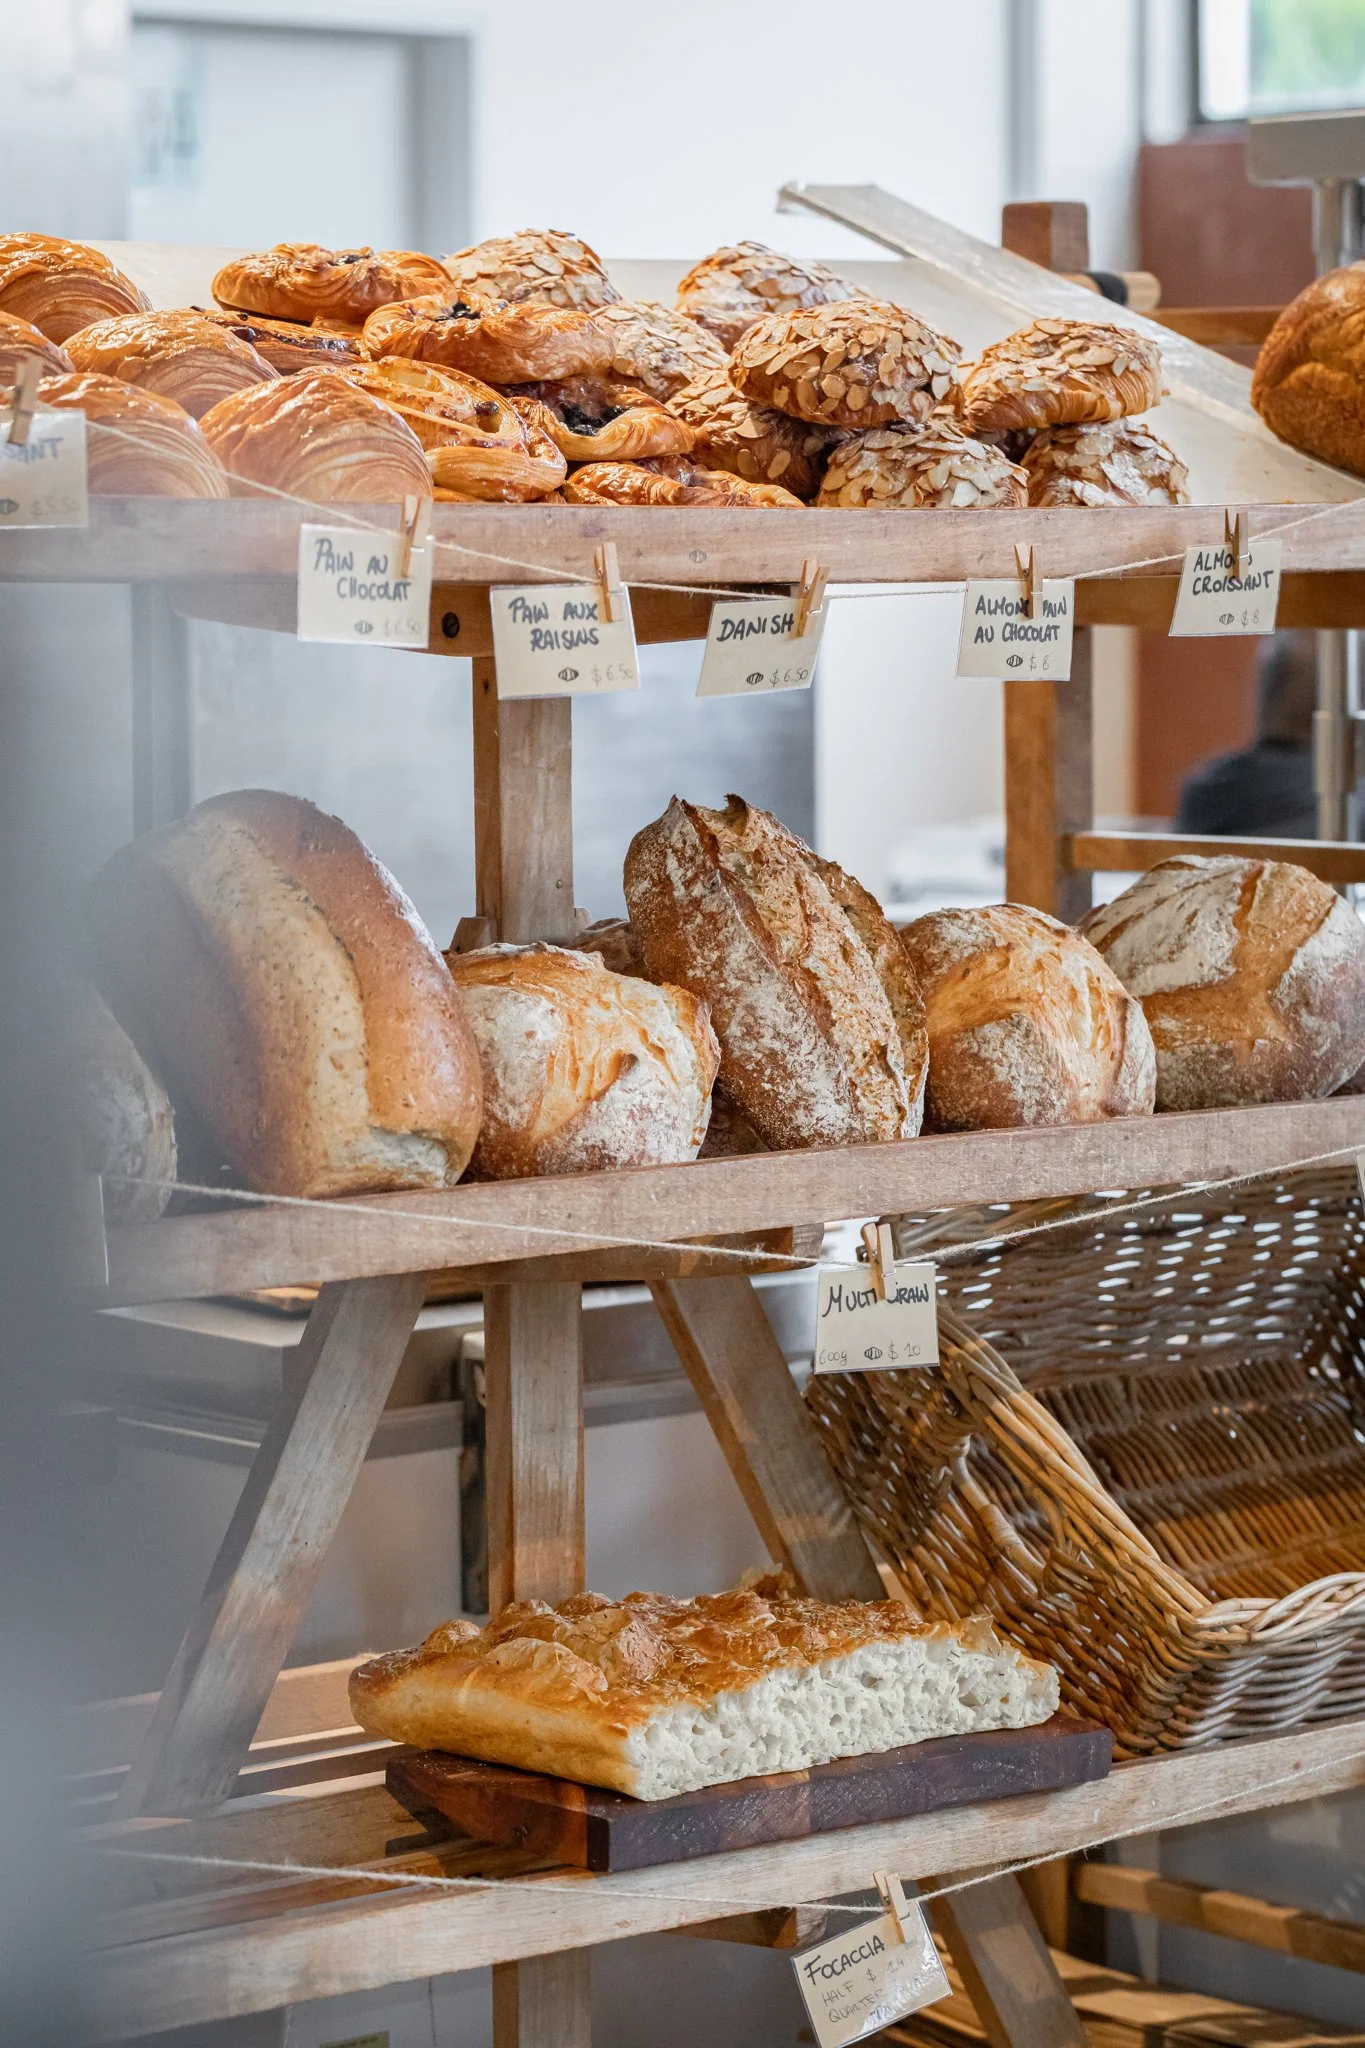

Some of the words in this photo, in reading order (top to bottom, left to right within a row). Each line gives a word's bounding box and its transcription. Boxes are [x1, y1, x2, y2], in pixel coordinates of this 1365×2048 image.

[313, 537, 354, 574] PAIN
[366, 554, 389, 575] AU
[1193, 549, 1253, 572] ALMO
[336, 576, 412, 602] CHOCOLAT
[1192, 570, 1274, 596] CROISSANT
[508, 596, 549, 624] PAIN
[563, 601, 598, 621] AUX
[975, 594, 1030, 618] ALMON
[1042, 596, 1067, 618] PAIN
[530, 628, 600, 652] RAISINS
[716, 612, 795, 642] DANISH
[974, 625, 995, 644] AU
[1001, 622, 1061, 643] CHOCOLAT
[803, 1934, 885, 1986] FOCACCIA
[821, 1979, 854, 2007] HALF
[827, 1988, 888, 2024] QUARTER
